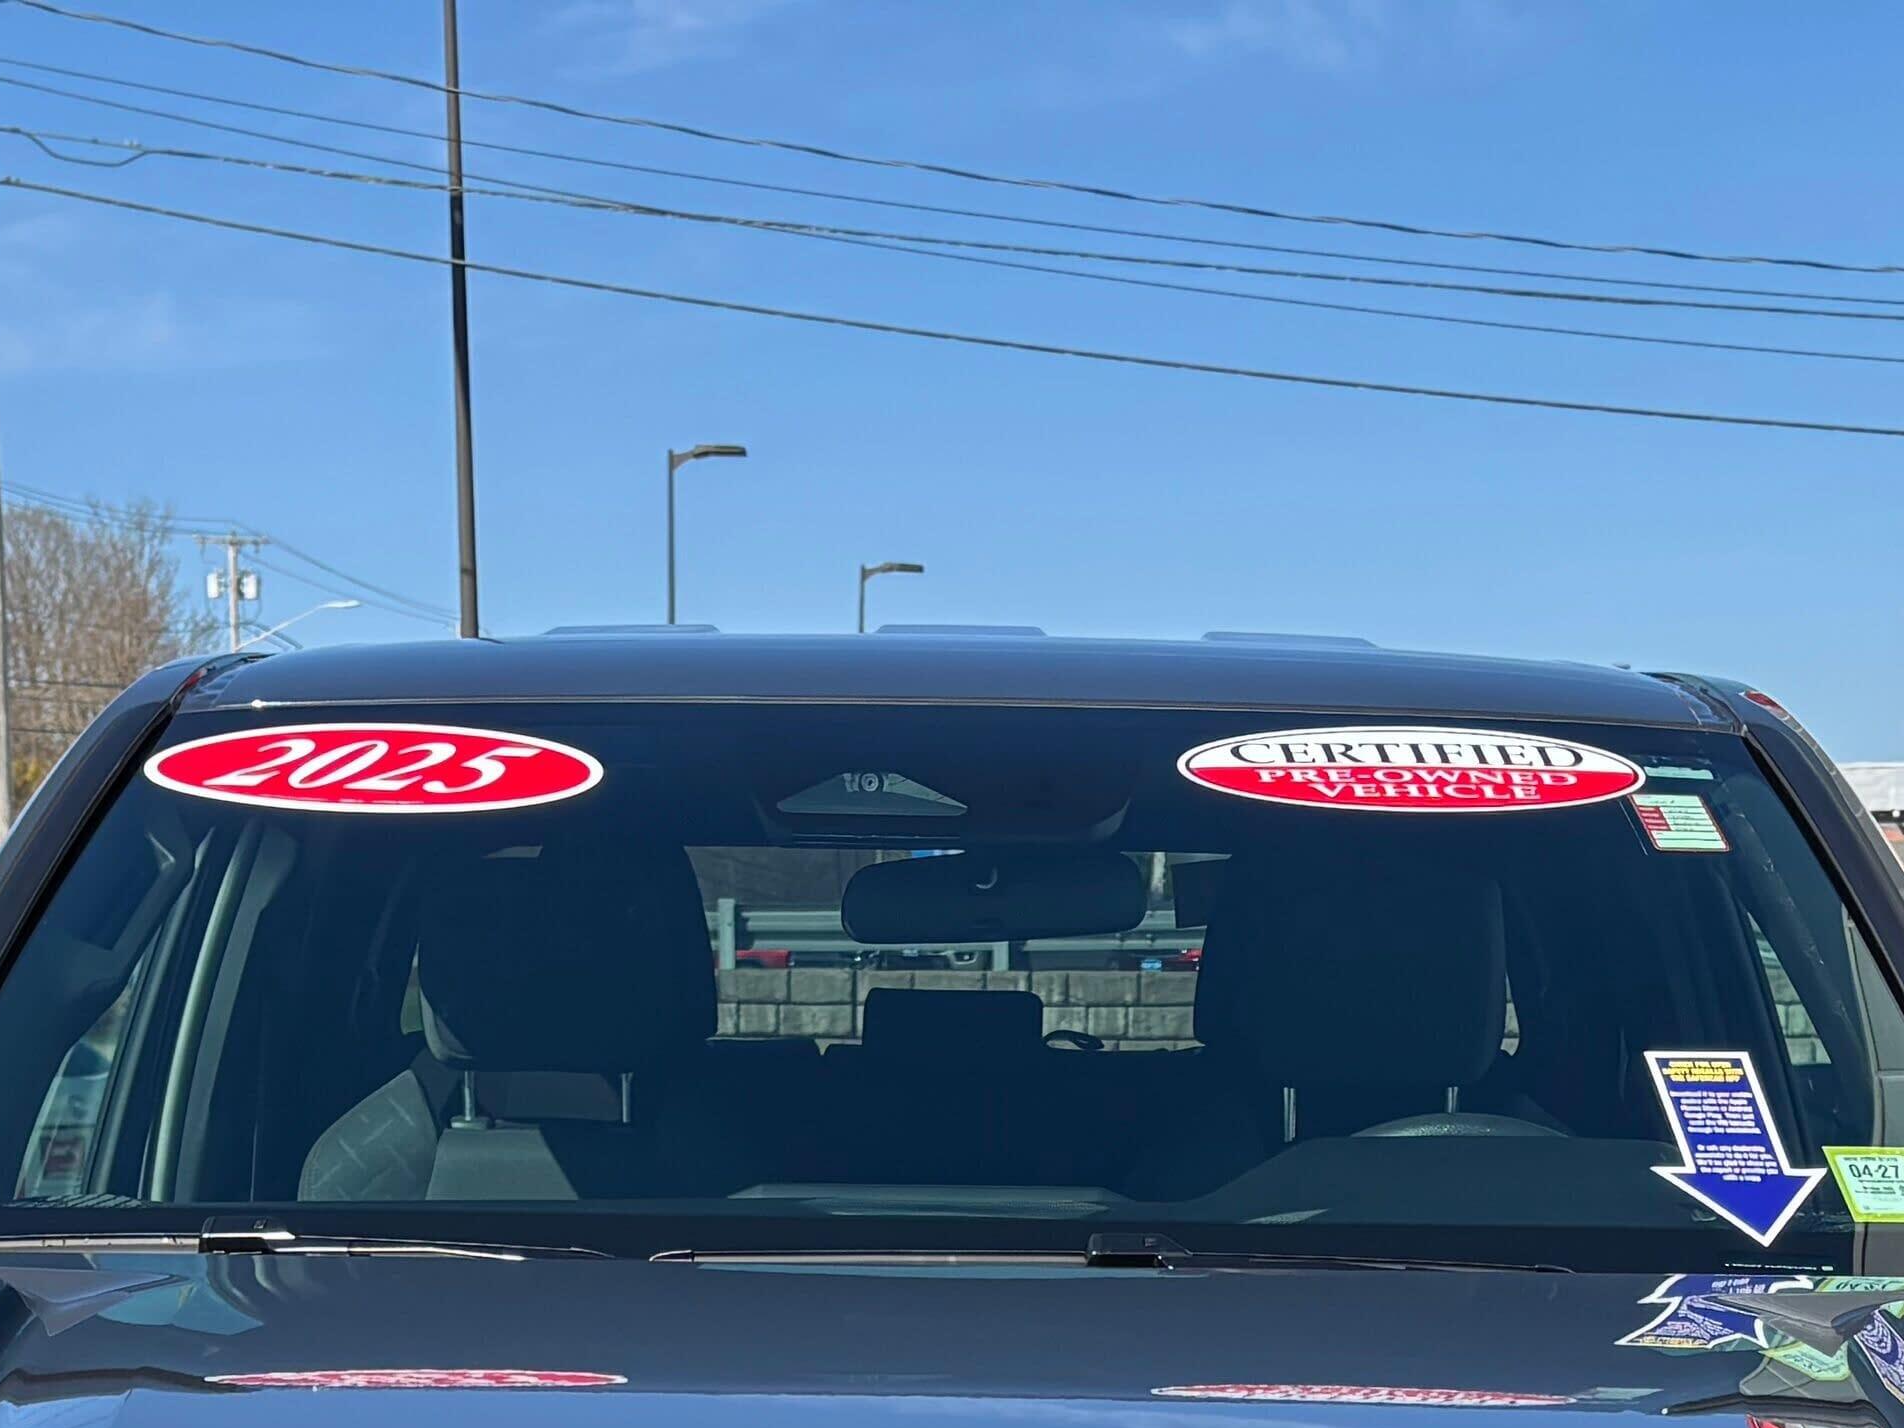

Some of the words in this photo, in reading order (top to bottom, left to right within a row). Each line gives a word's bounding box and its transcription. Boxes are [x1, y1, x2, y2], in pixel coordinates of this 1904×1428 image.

[1229, 742, 1584, 769] CERTIFIED
[203, 739, 543, 794] 2025
[1254, 768, 1579, 787] PRE-OWNED
[1306, 782, 1542, 800] VEHICLE
[1848, 1163, 1901, 1179] 04-27
